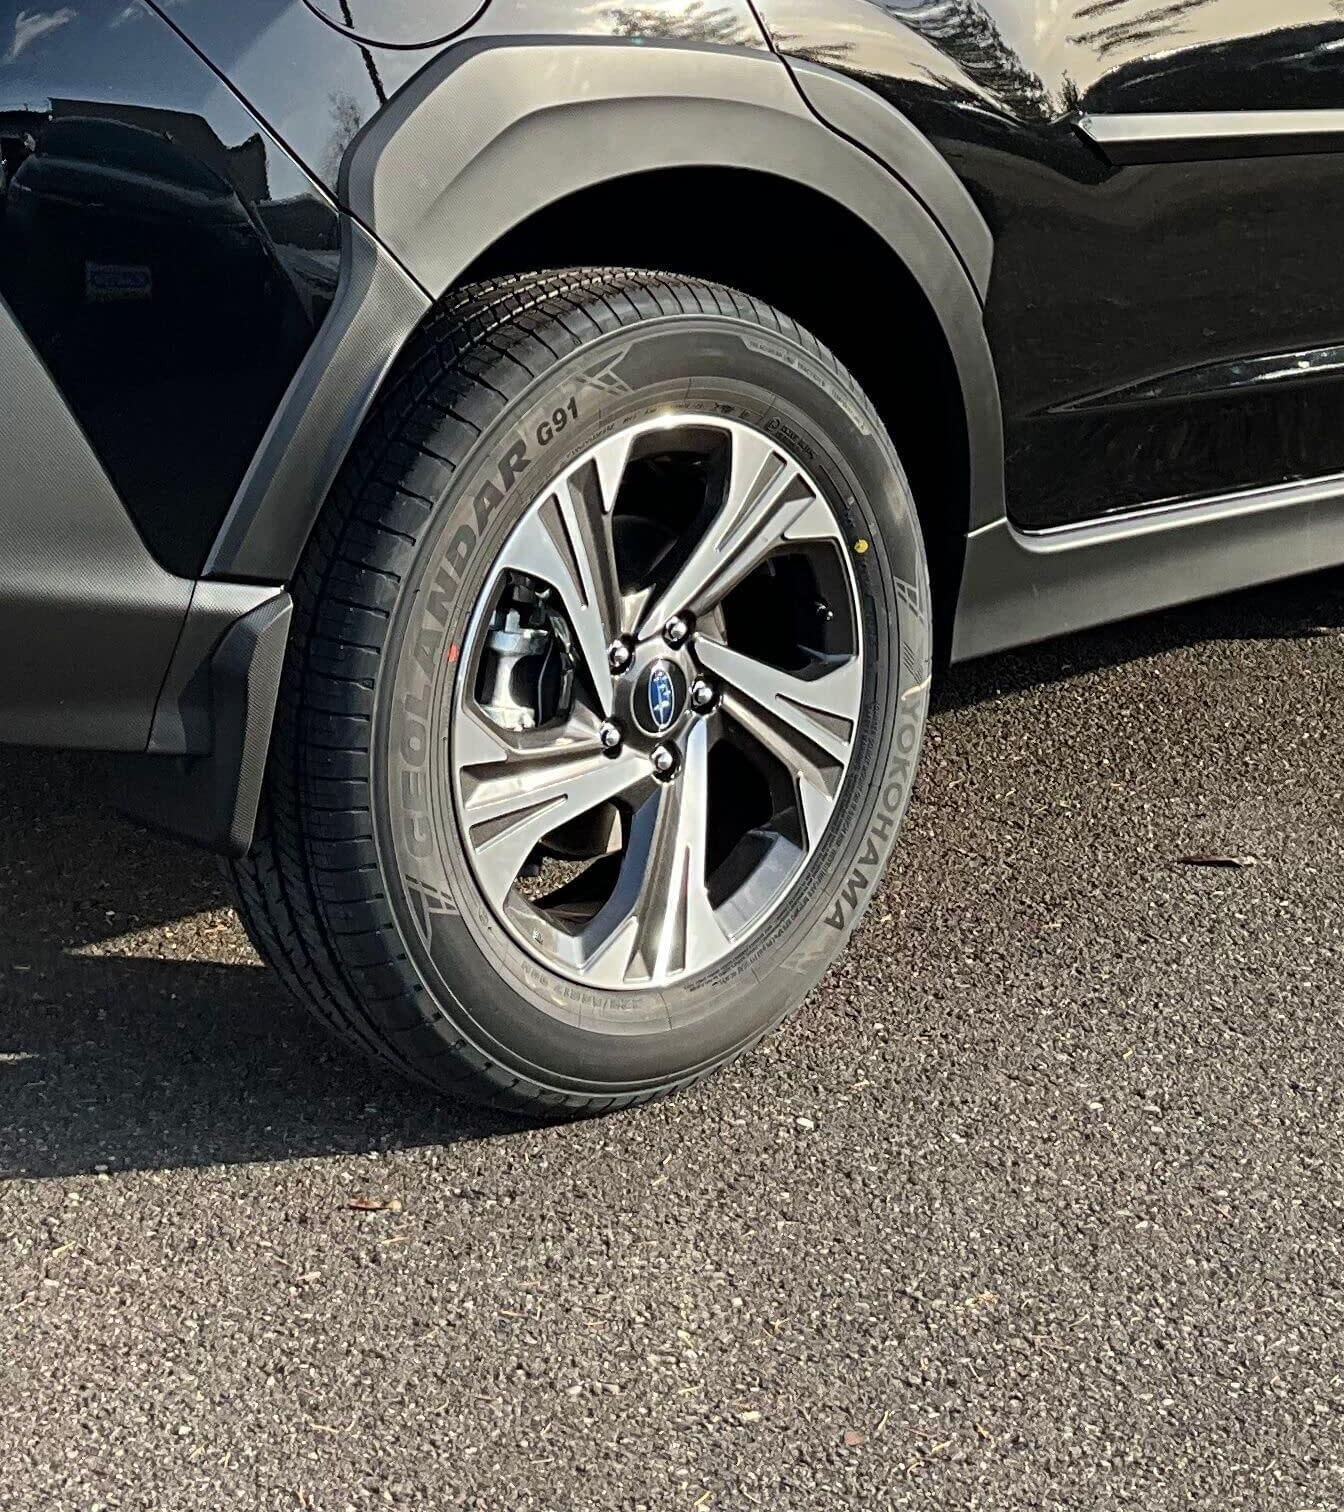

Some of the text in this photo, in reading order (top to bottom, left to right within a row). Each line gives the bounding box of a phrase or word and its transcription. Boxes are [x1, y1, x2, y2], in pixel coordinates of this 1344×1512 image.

[399, 396, 578, 860] GEOLANDAR G91
[823, 699, 920, 930] YOKOHAMA
